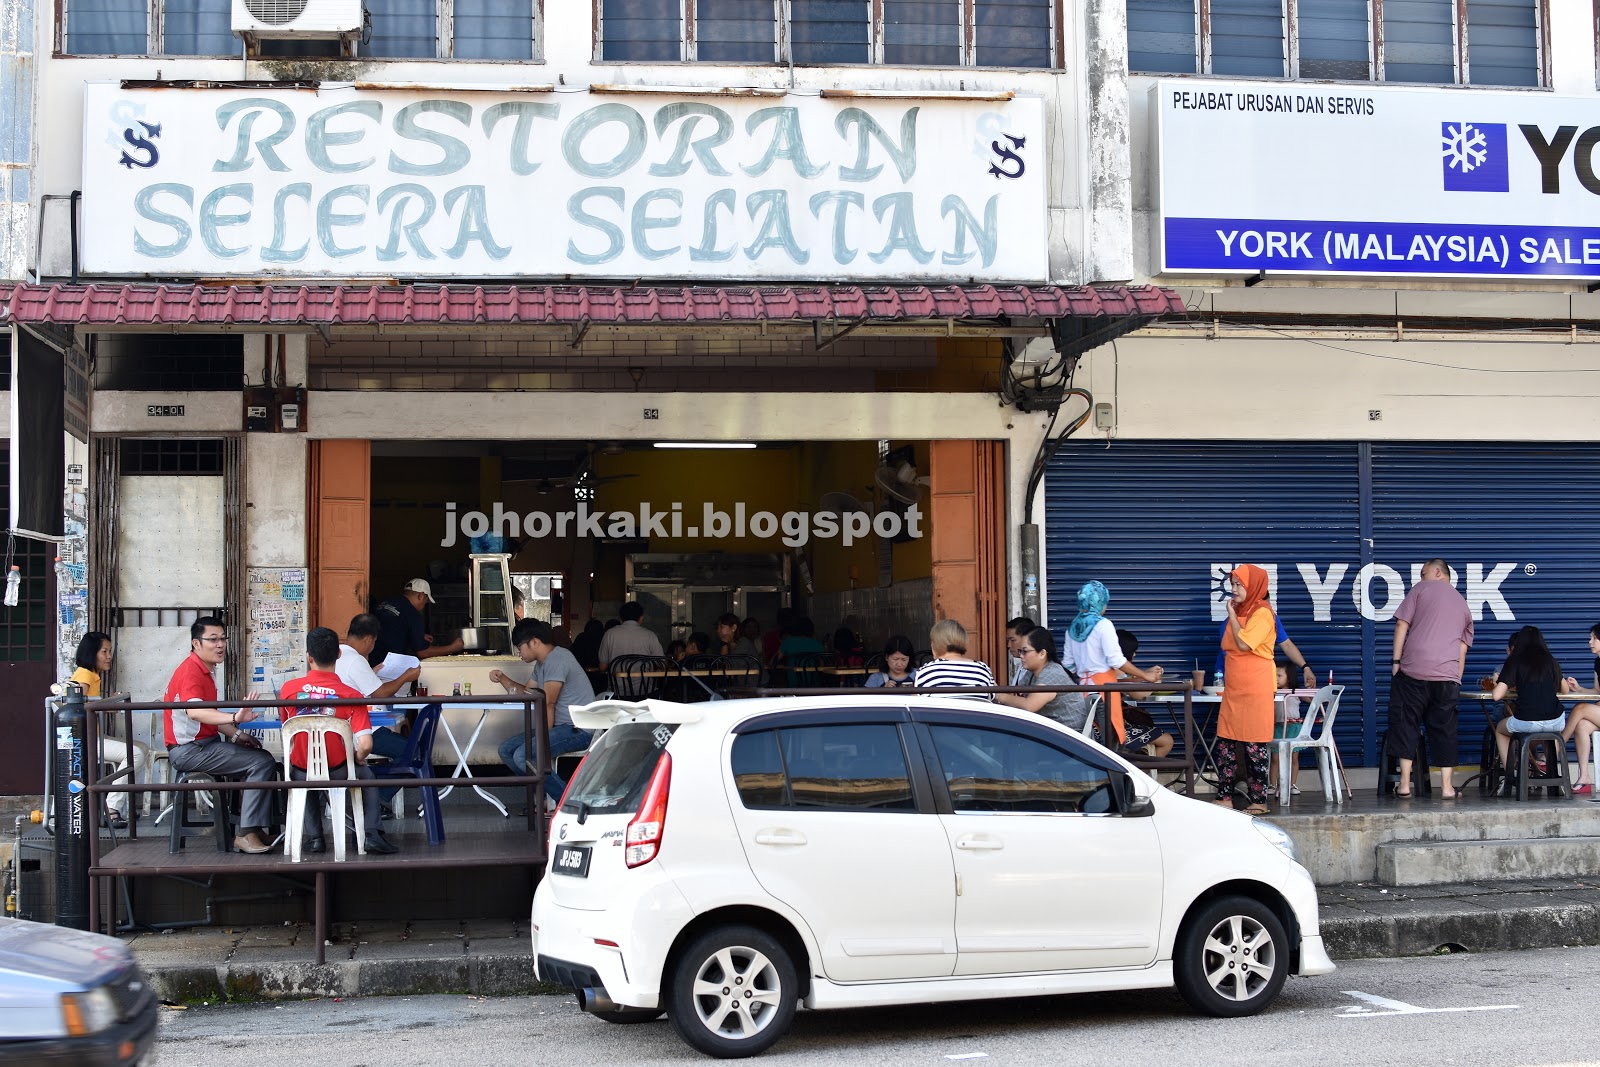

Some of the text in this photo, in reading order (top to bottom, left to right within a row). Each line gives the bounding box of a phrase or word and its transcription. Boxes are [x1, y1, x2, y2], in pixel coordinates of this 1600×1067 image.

[1173, 91, 1374, 116] PEJABAT URUSAN DAN SERVIS
[211, 98, 920, 184] RESTORAN
[134, 182, 1003, 269] SELERA SELATAN
[1215, 230, 1600, 269] YORK (MALAYSIA) SALE
[148, 405, 185, 415] 34-01
[644, 409, 658, 418] 34
[312, 685, 336, 695] NITTO
[73, 739, 82, 835] INTACT WATER
